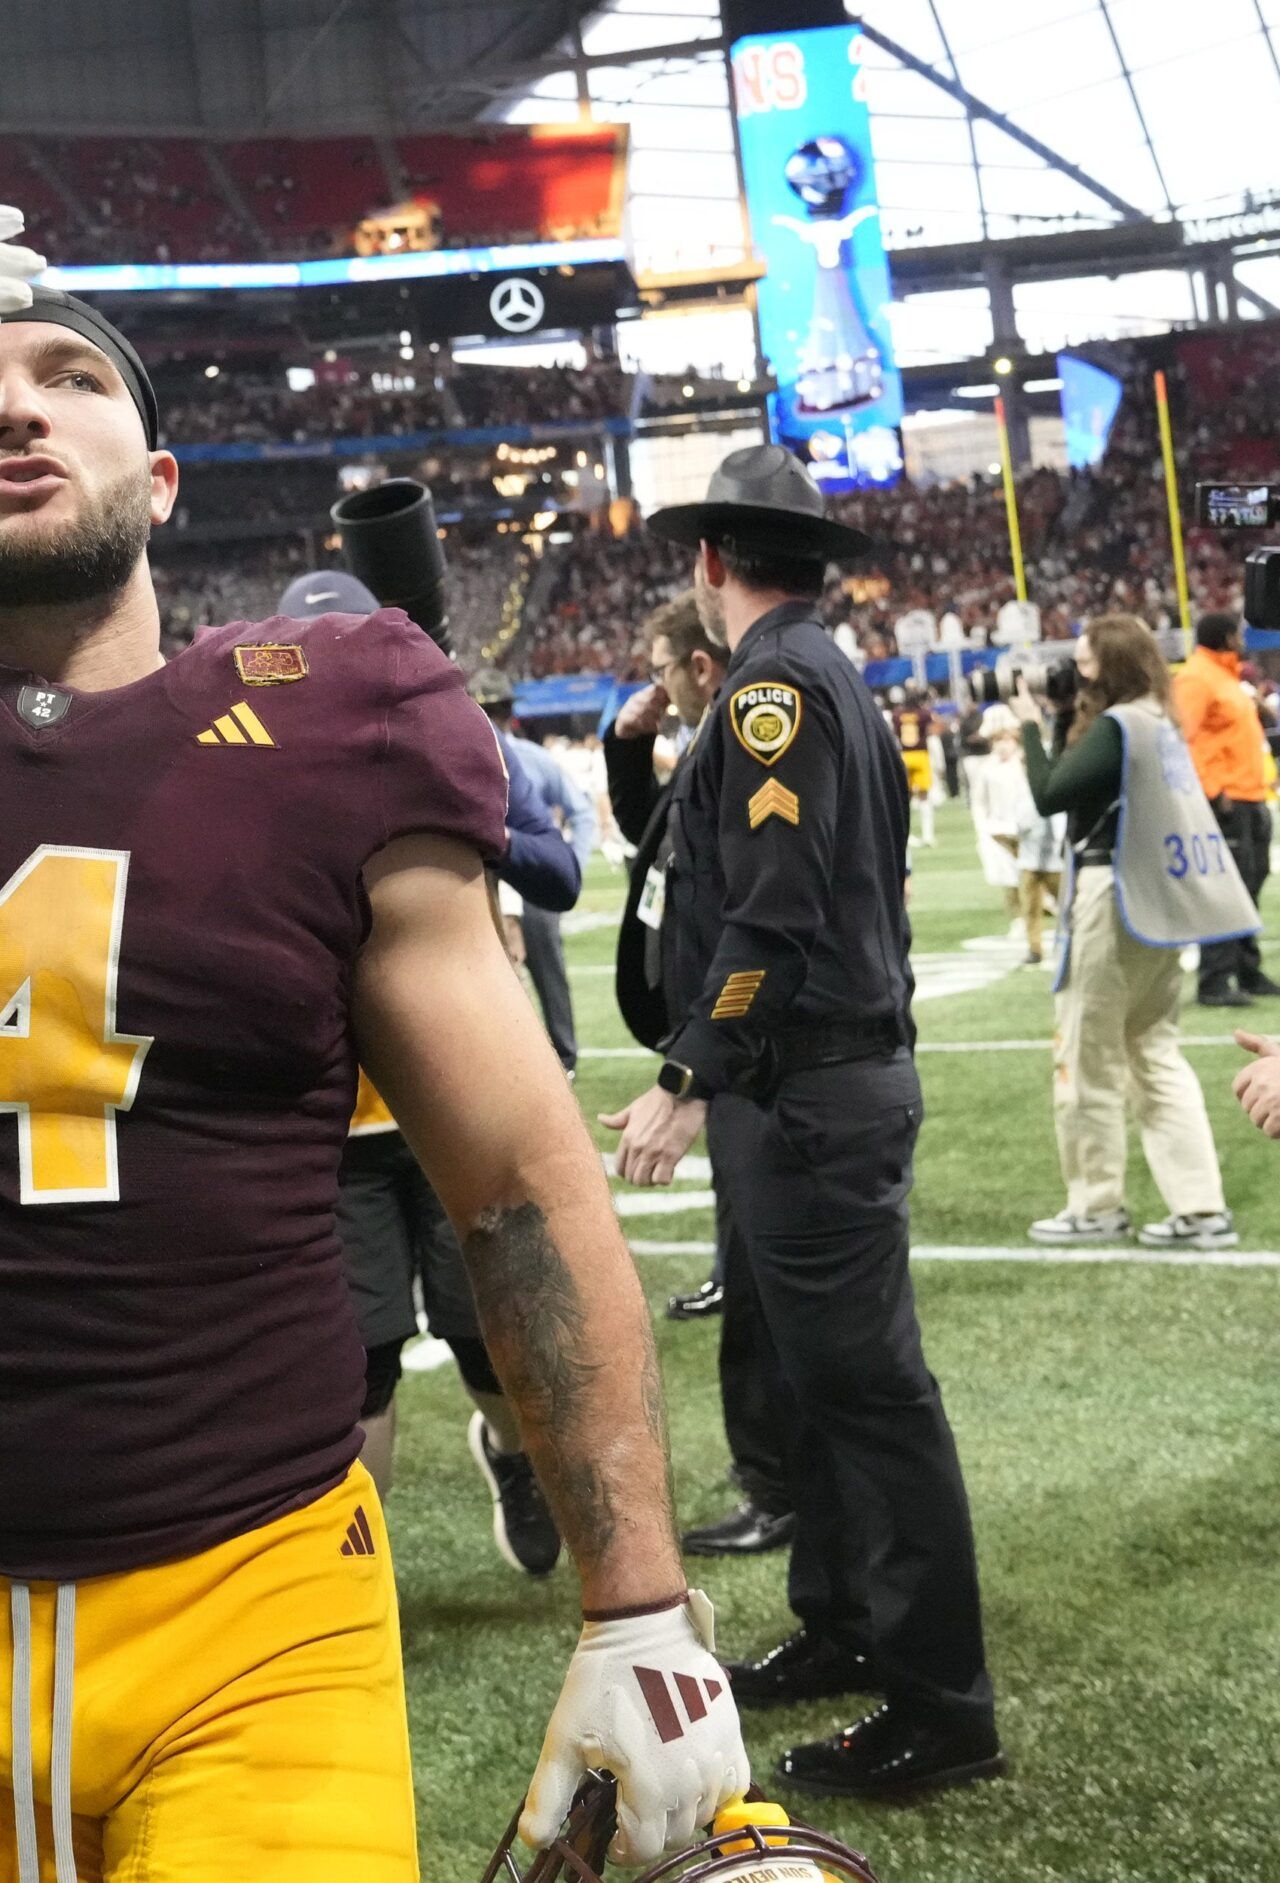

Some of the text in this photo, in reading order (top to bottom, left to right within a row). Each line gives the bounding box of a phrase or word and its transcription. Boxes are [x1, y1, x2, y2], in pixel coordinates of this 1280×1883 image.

[36, 692, 56, 704] PT
[738, 688, 793, 709] POLICE
[32, 706, 52, 718] 42
[1164, 832, 1226, 879] 307
[779, 1867, 812, 1879] SUN
